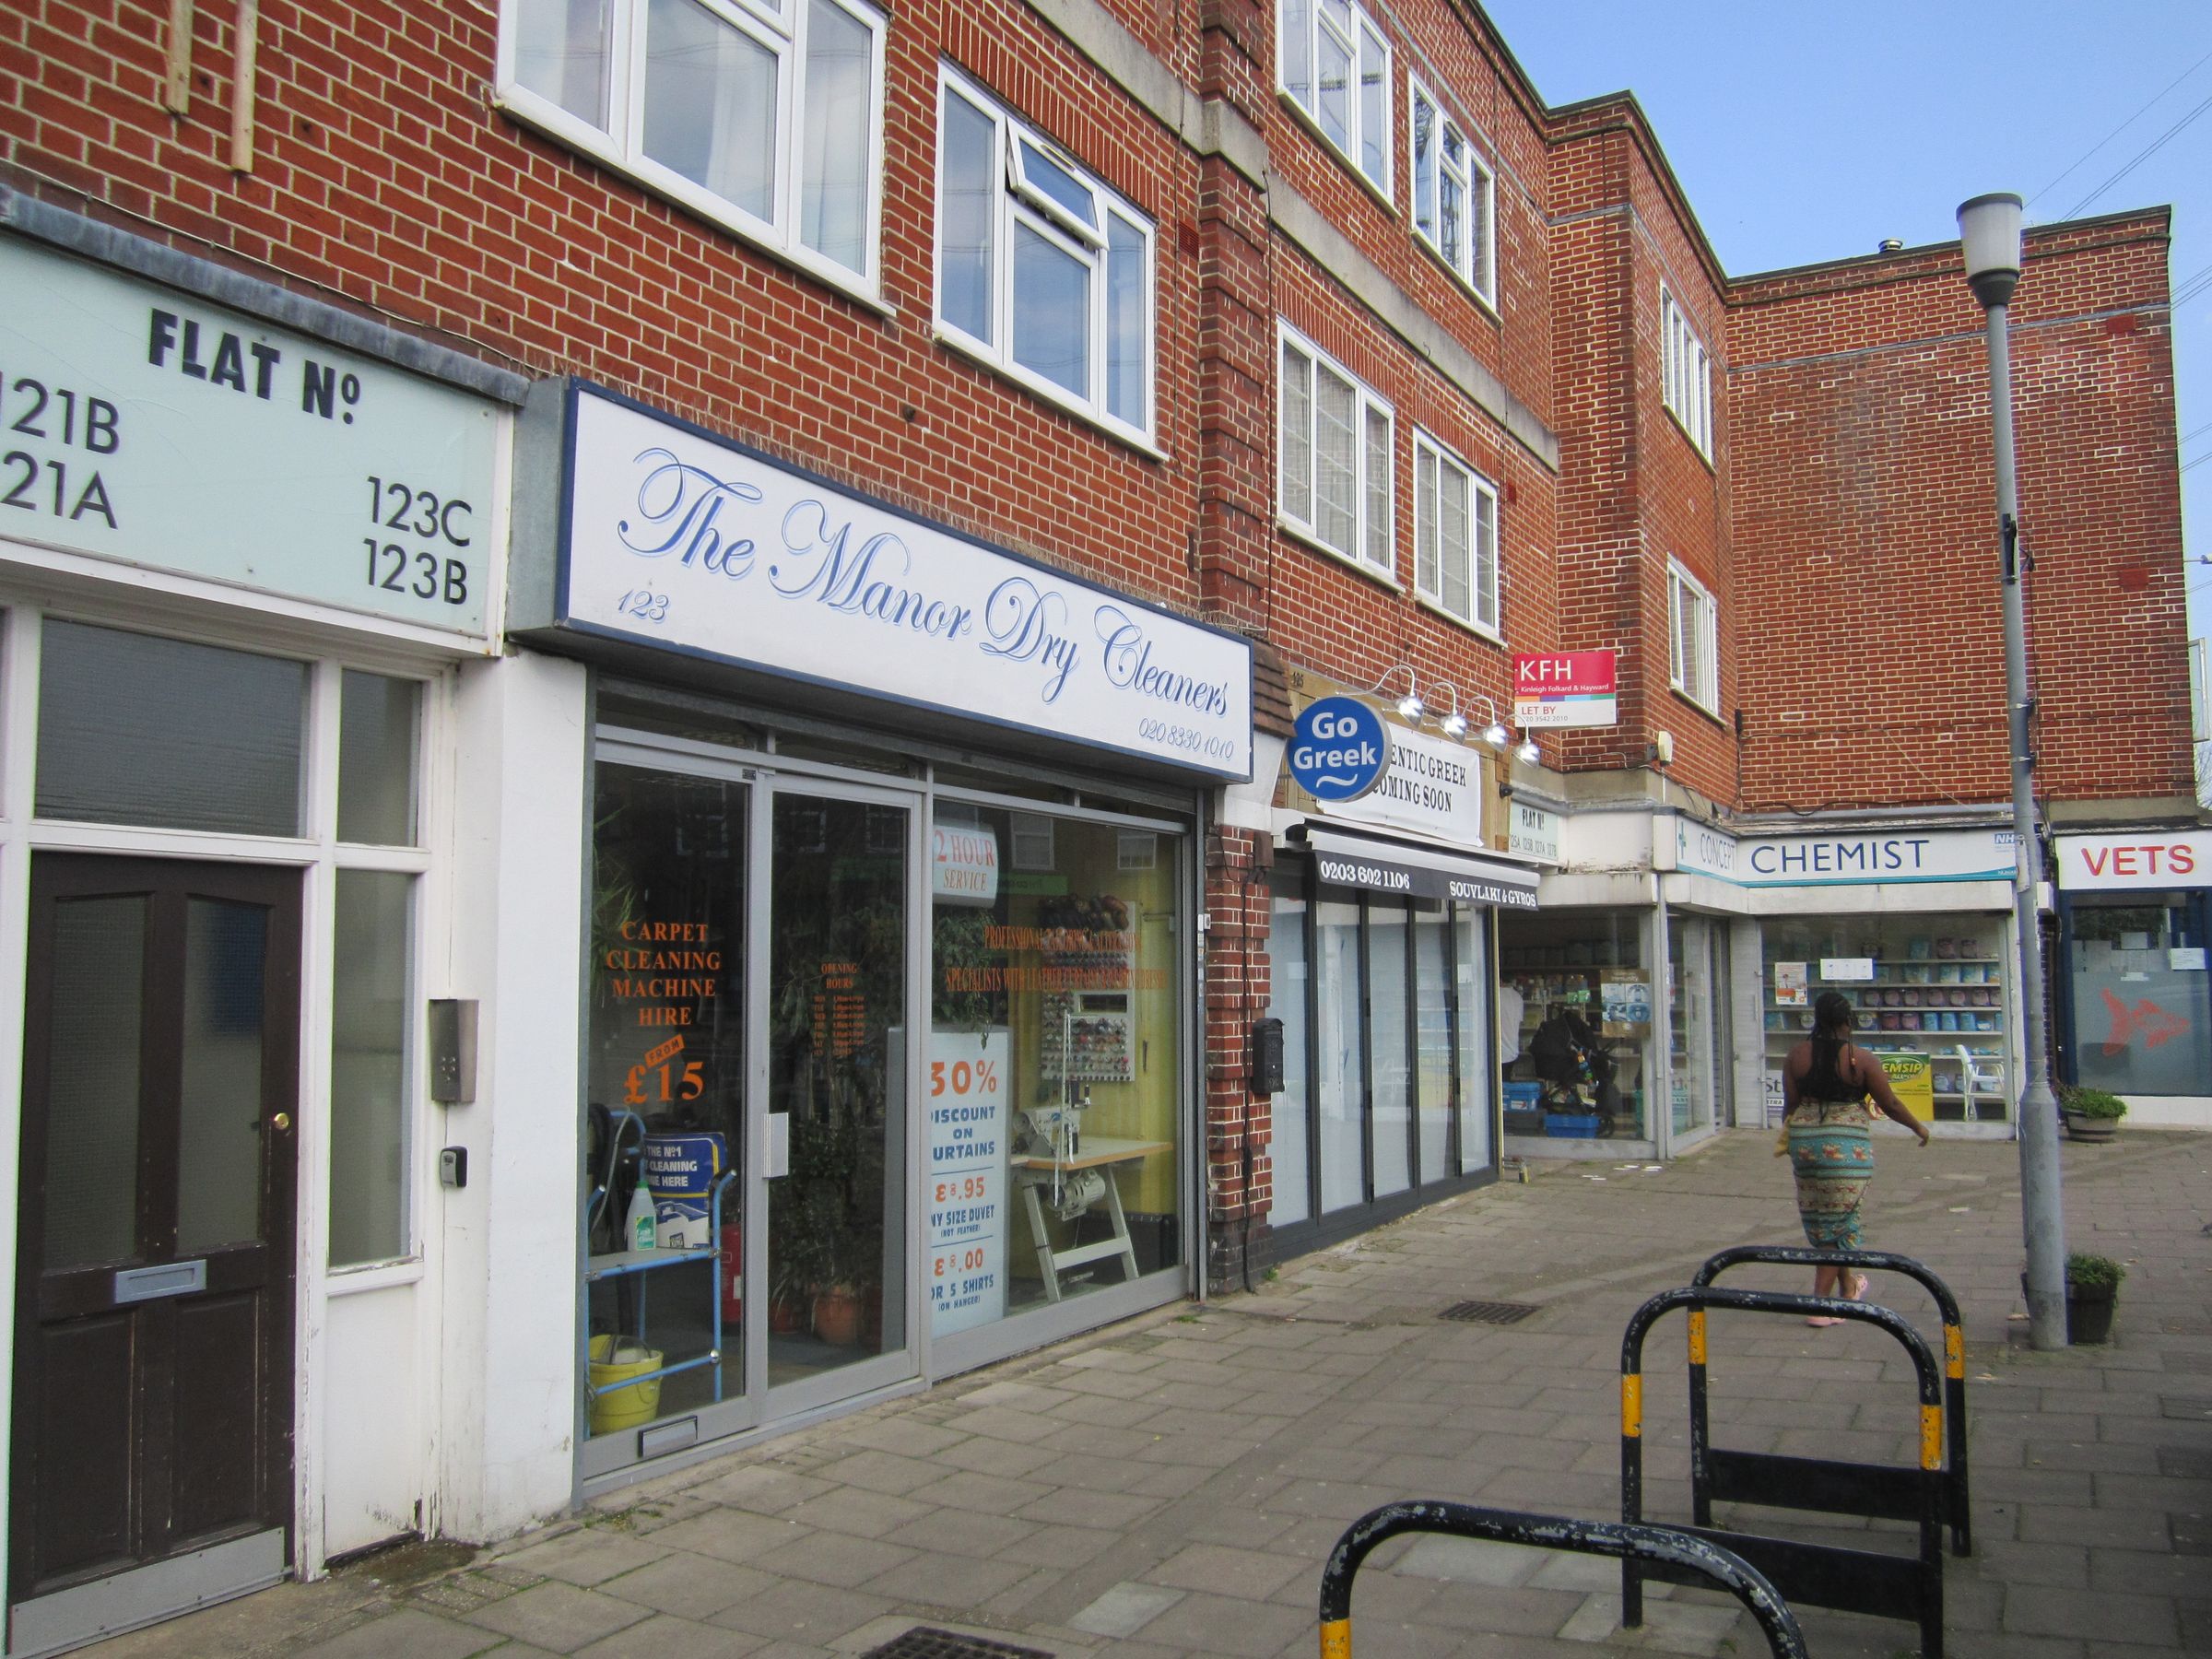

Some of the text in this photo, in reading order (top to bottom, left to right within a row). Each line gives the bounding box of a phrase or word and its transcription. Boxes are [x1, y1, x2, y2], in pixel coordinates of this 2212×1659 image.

[148, 308, 280, 400] FLAT
[0, 371, 120, 454] 21B
[0, 451, 118, 530] 21A
[367, 476, 472, 547] 123C
[363, 537, 468, 605] 123B
[618, 447, 1228, 715] The Manor Dry Cleaners
[618, 589, 669, 623] 123
[1521, 659, 1571, 681] KFH
[1521, 686, 1547, 694] Kinleigh
[1548, 684, 1571, 693] Folkard
[1581, 683, 1609, 693] Hayward
[1522, 706, 1557, 715] LET BY
[1312, 712, 1359, 739] Go
[1139, 718, 1234, 759] 020 8330 1010
[1293, 741, 1378, 770] Greek
[1391, 744, 1467, 787] ENTIC GREEK
[1423, 785, 1453, 813] SOON
[1523, 808, 1535, 829] FLAT
[1995, 834, 2015, 843] NH
[950, 835, 994, 866] HOUR
[1700, 832, 1930, 874] CONCEPT CHEMIST
[2081, 845, 2194, 876] VETS
[944, 869, 987, 891] SERVICE
[1321, 861, 1410, 890] 0203 602 1106
[1450, 881, 1536, 907] SOUVLAKI & GYROS
[621, 922, 708, 941] CARPET
[606, 950, 721, 970] CLEANING
[821, 963, 857, 973] OPENING
[613, 979, 715, 996] MACHINE
[826, 978, 853, 989] HOURS
[946, 967, 1001, 992] SPECIALISTS
[1003, 968, 1026, 991] WITH
[639, 1007, 691, 1026] HIRE
[648, 1039, 680, 1061] FROM
[1882, 1063, 1923, 1074] EMSIP
[623, 1062, 703, 1104] £15
[931, 1106, 994, 1123] ISCOUNT
[953, 1127, 972, 1139] ON
[647, 1146, 662, 1157] THE
[933, 1142, 994, 1160] URTAINS
[649, 1160, 698, 1171] CLEANING
[662, 1176, 688, 1187] HERE
[946, 1209, 966, 1226] SIZE
[969, 1205, 994, 1222] DUVET
[941, 1227, 981, 1237] (NOT FEATHER)
[963, 1275, 994, 1294] SHIRTS
[938, 1300, 949, 1312] (ON
